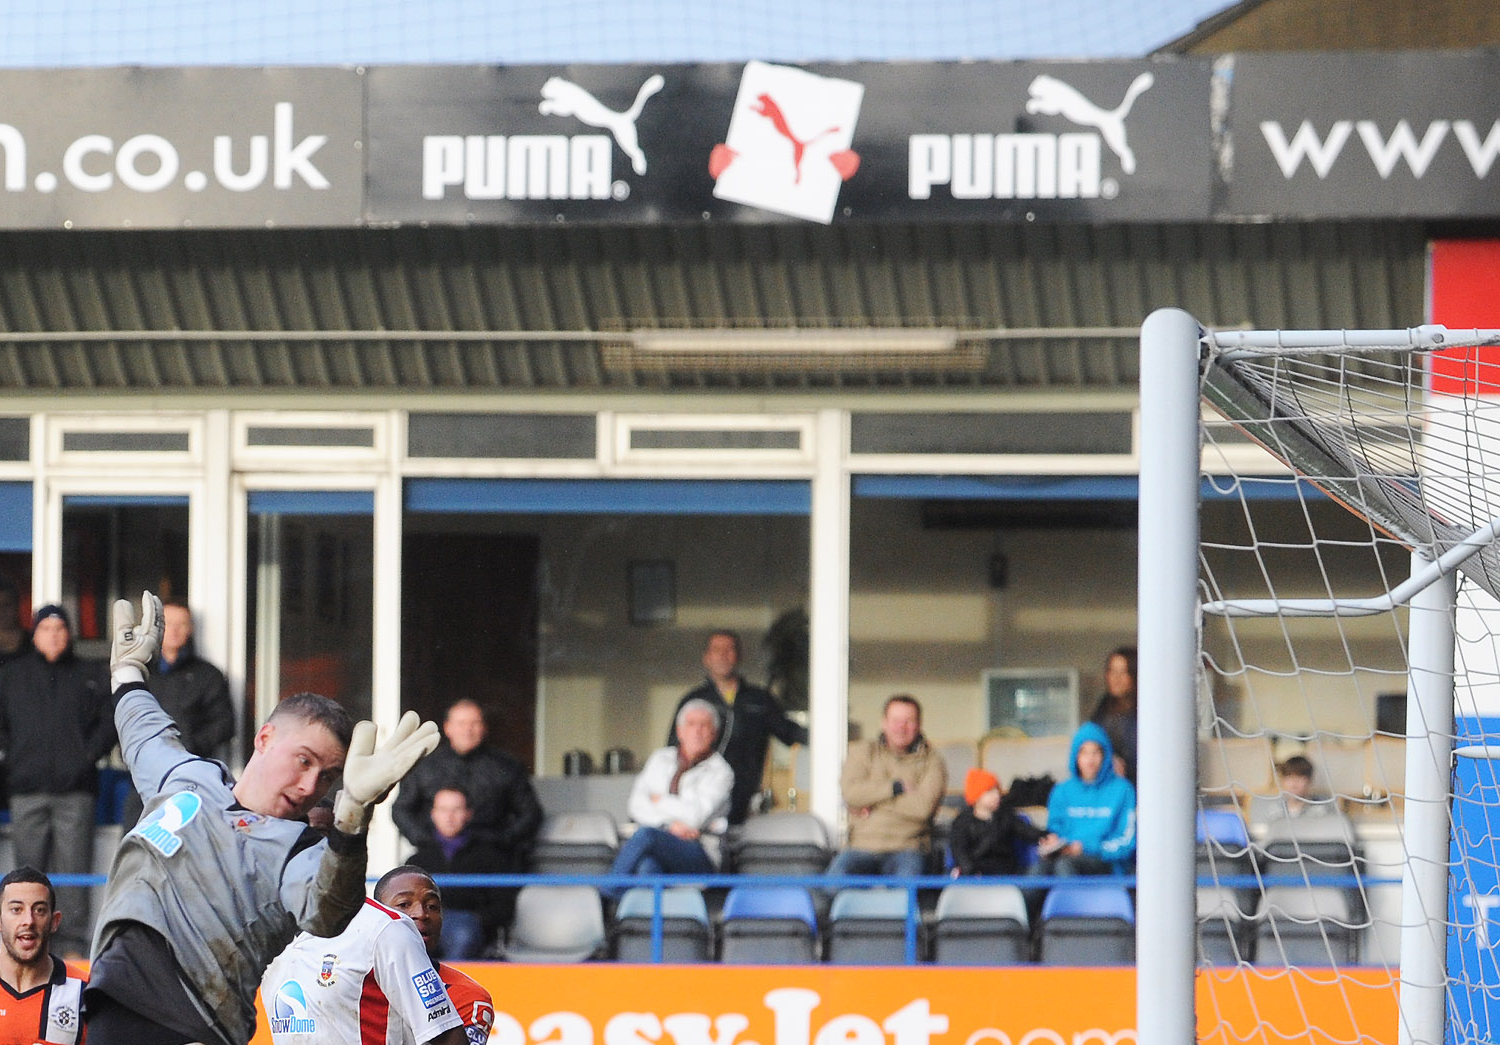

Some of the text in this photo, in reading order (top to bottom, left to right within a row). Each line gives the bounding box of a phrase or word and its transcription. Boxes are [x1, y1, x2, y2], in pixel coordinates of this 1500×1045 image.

[423, 135, 613, 199] PUMA
[908, 133, 1100, 199] PUMA
[414, 970, 437, 988] BLUE
[419, 983, 437, 998] SQ
[271, 1016, 316, 1034] SnowDome
[466, 1028, 485, 1044] BLU
